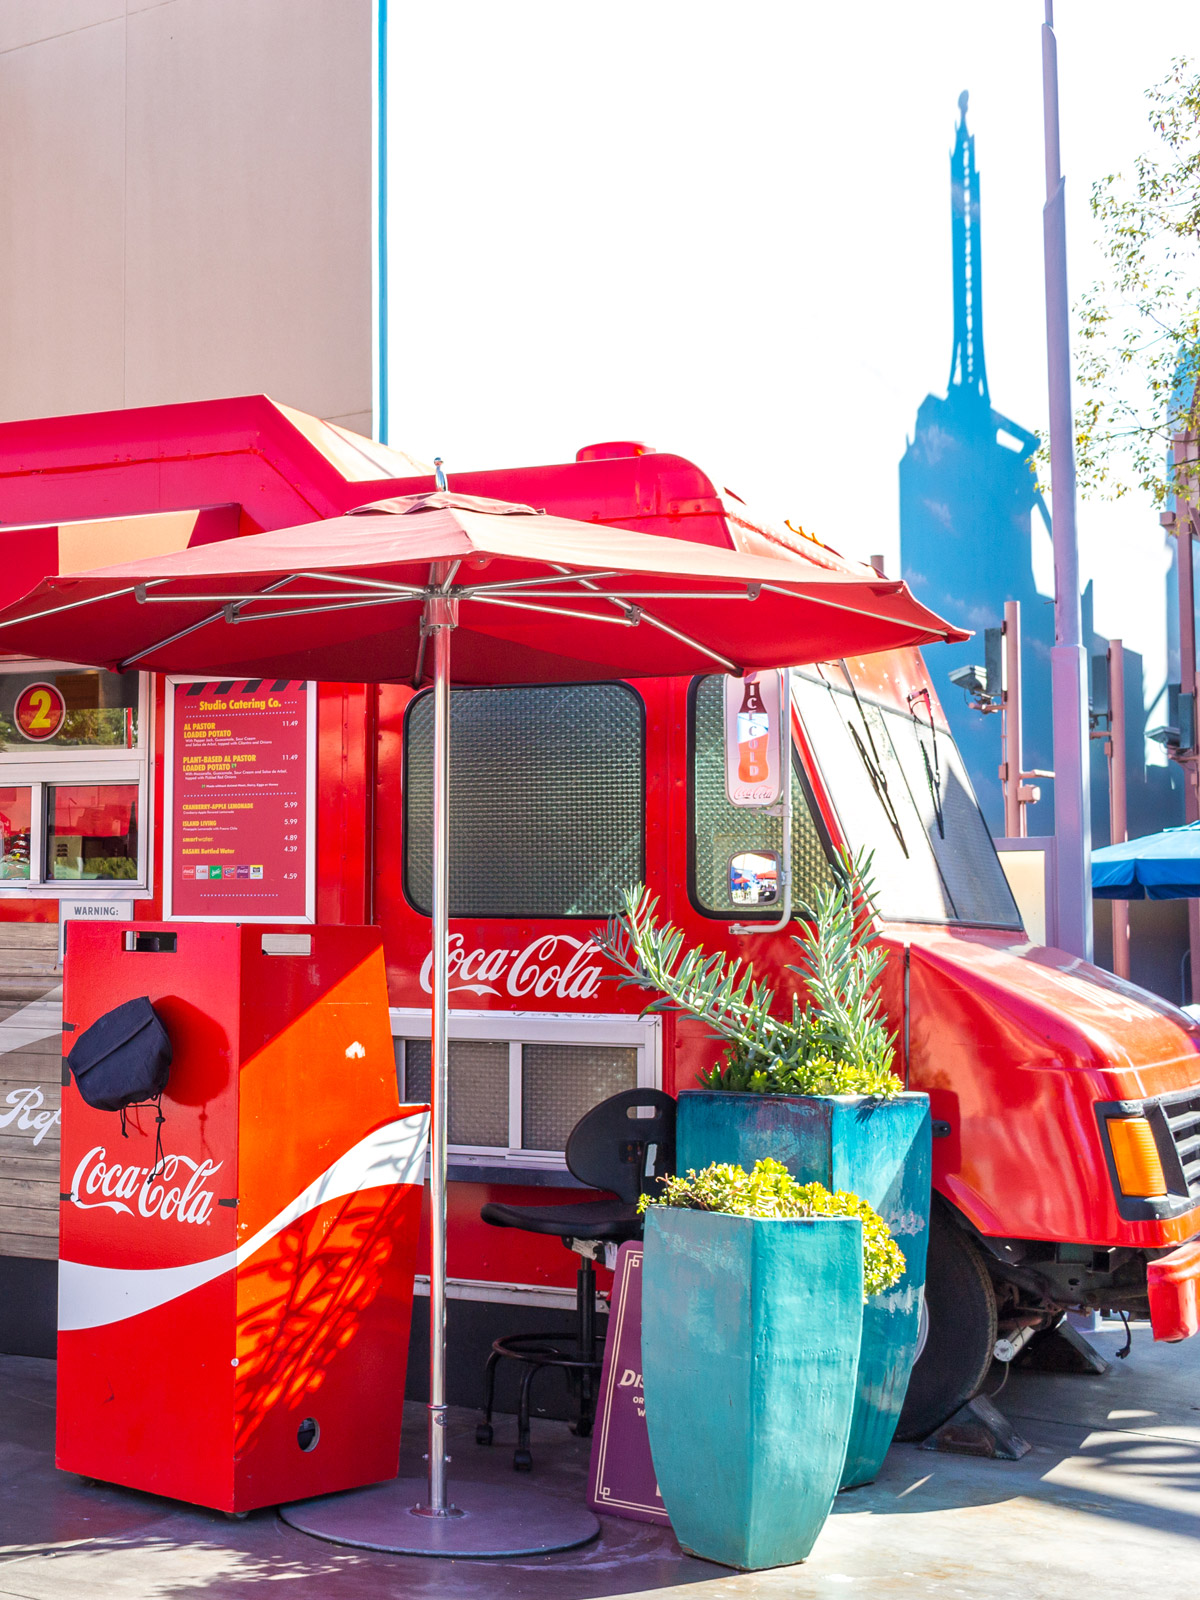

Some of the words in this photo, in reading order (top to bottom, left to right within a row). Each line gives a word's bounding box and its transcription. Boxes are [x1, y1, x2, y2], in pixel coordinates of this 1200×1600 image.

[29, 690, 51, 728] 2
[199, 700, 227, 711] Studio
[229, 698, 266, 710] Catering
[268, 697, 282, 708] Co.
[193, 722, 216, 730] PASTOR
[184, 731, 207, 739] LOADED
[208, 730, 232, 738] POTATO
[183, 756, 222, 764] PLANT-BASED
[233, 754, 256, 762] PASTOR
[183, 764, 206, 772] LOADED
[207, 763, 230, 771] POTATO
[74, 906, 119, 916] WARNING:
[419, 933, 607, 999] Coca-Cola
[71, 1146, 223, 1226] Coca-Cola
